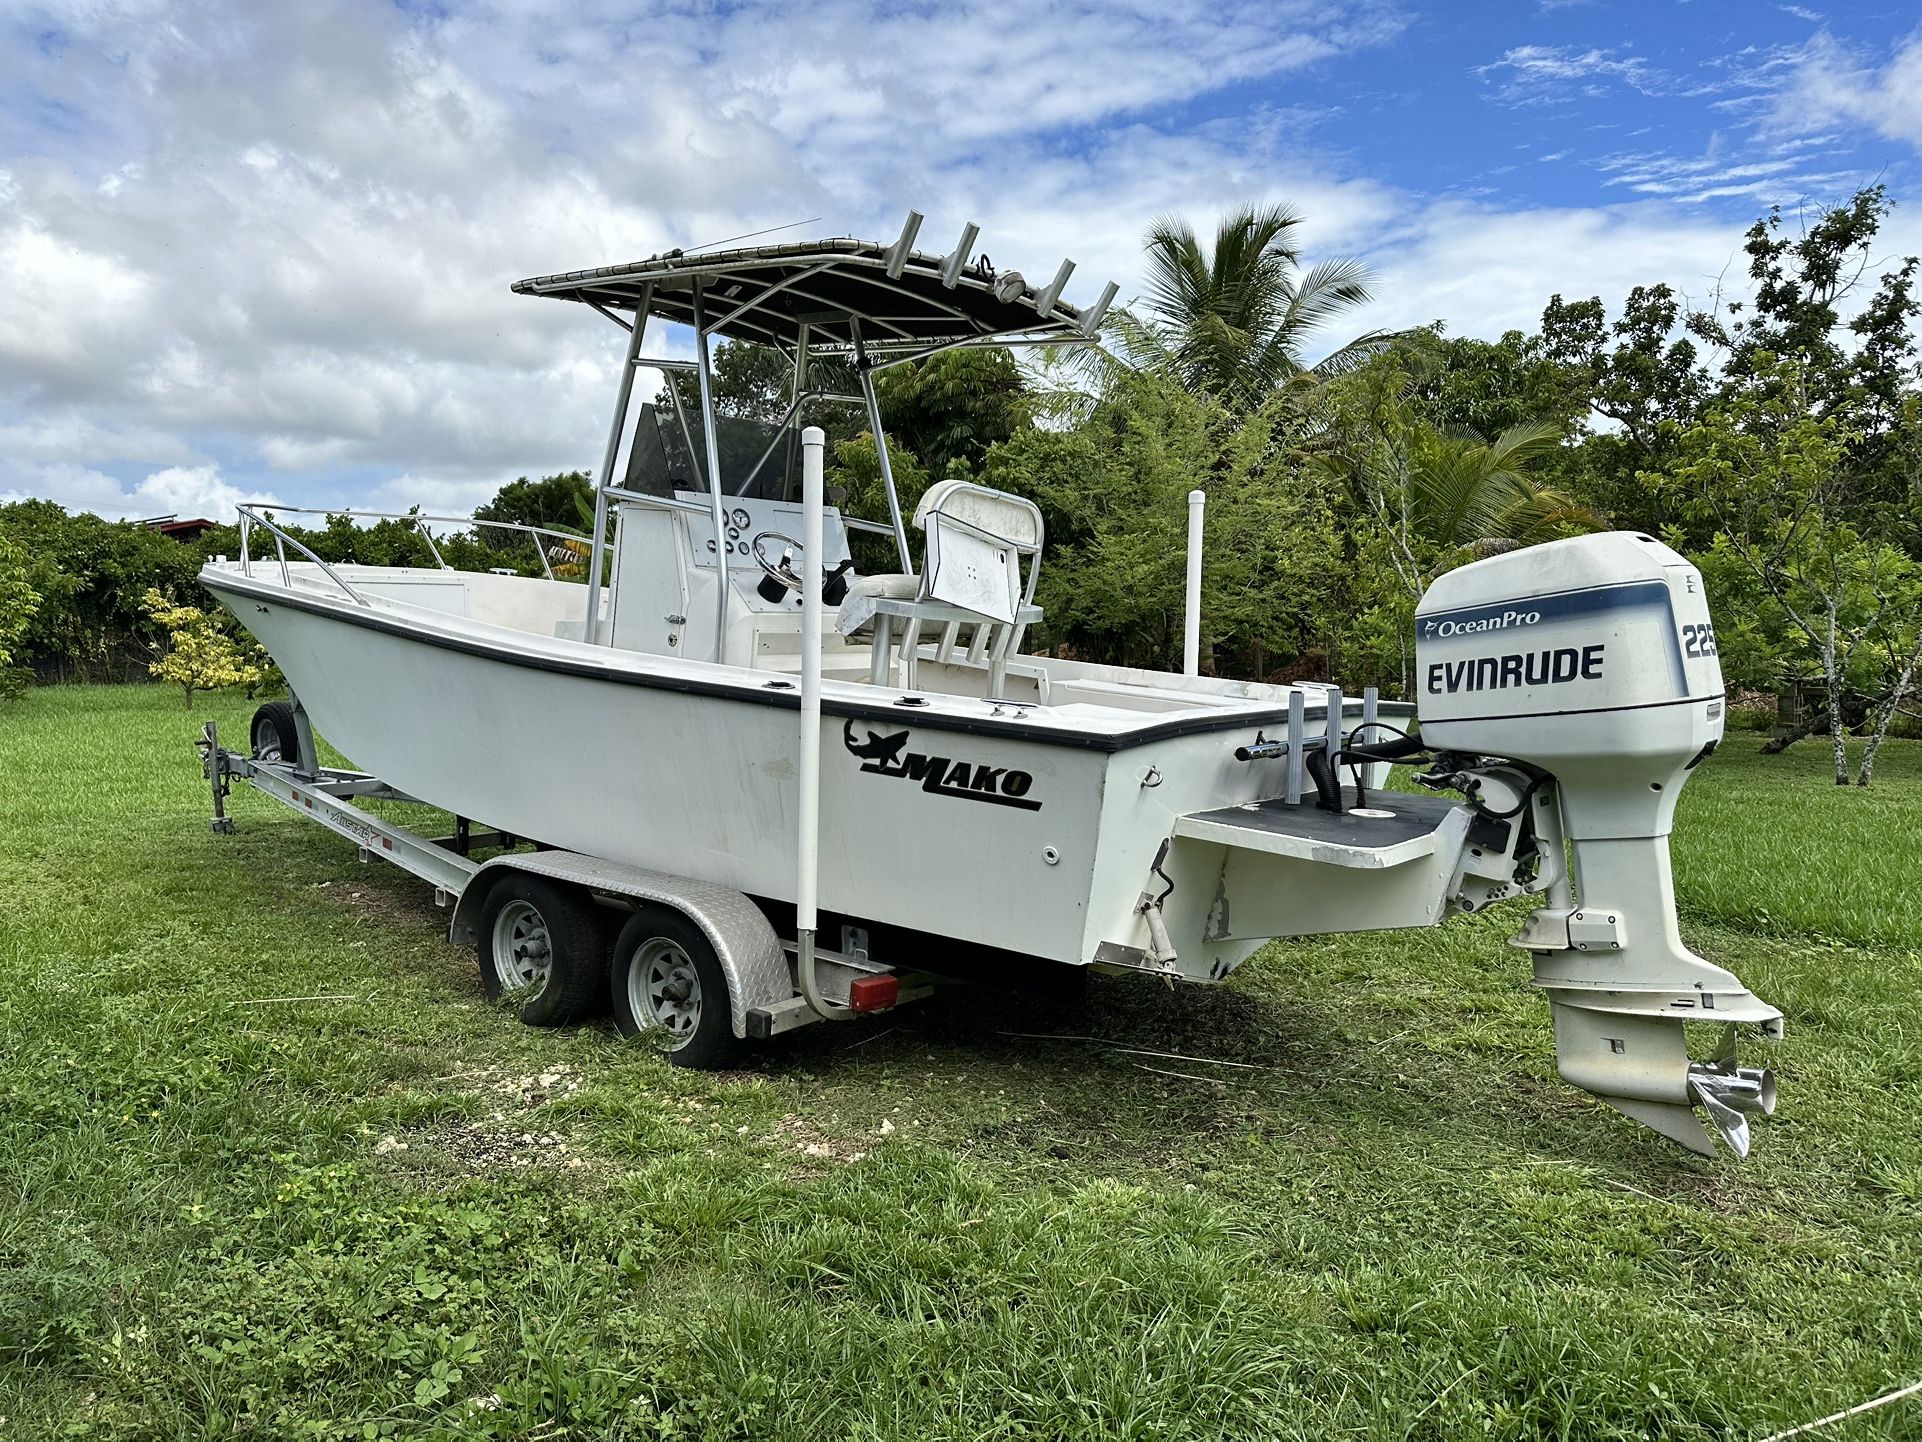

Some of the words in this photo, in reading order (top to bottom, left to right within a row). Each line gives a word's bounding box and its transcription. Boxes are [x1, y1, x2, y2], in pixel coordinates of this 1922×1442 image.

[1438, 611, 1540, 638] OceanPro
[1428, 644, 1605, 695] EVINRUDE
[898, 752, 1033, 797] MAKO
